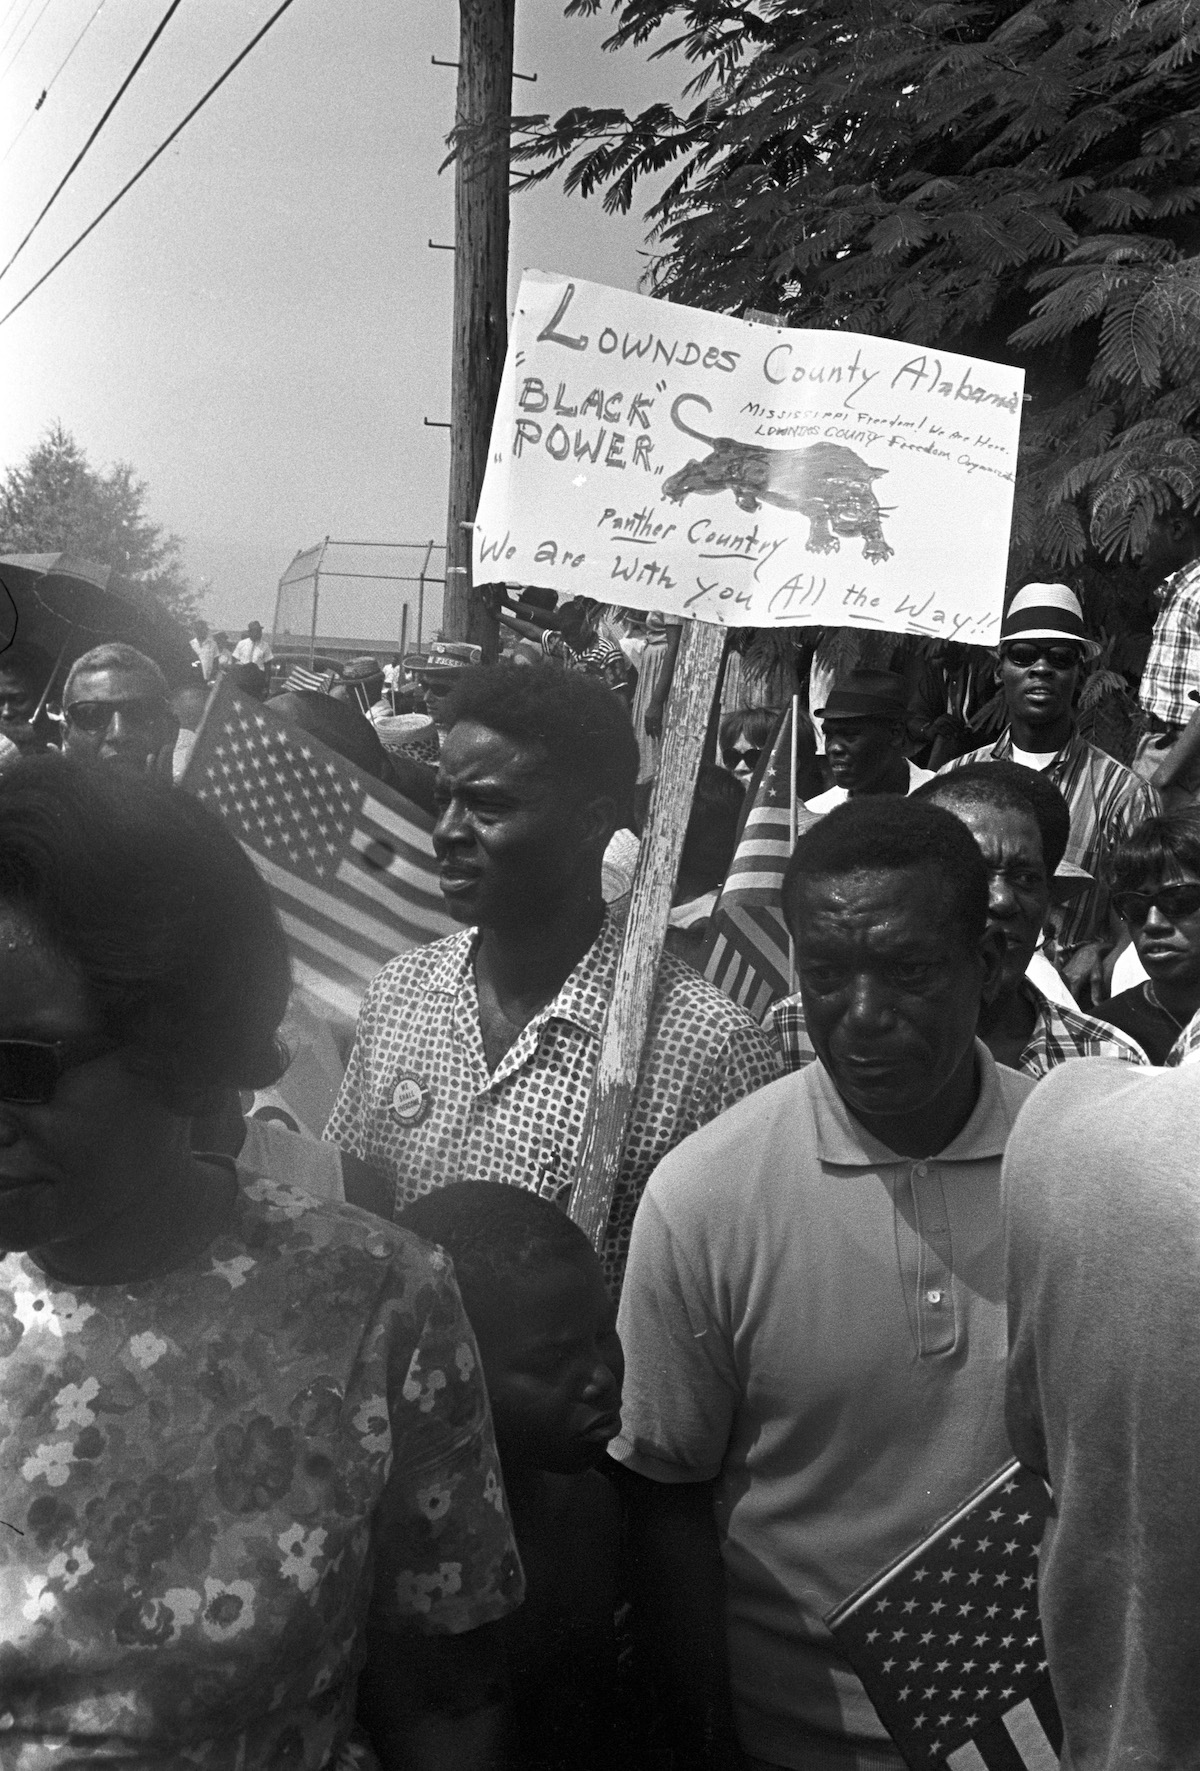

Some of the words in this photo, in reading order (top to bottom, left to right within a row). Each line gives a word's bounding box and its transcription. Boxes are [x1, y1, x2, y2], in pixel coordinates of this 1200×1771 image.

[763, 343, 880, 409] County
[479, 530, 517, 563] We
[842, 584, 881, 607] the
[597, 506, 677, 541] Panther
[687, 518, 789, 583] Country
